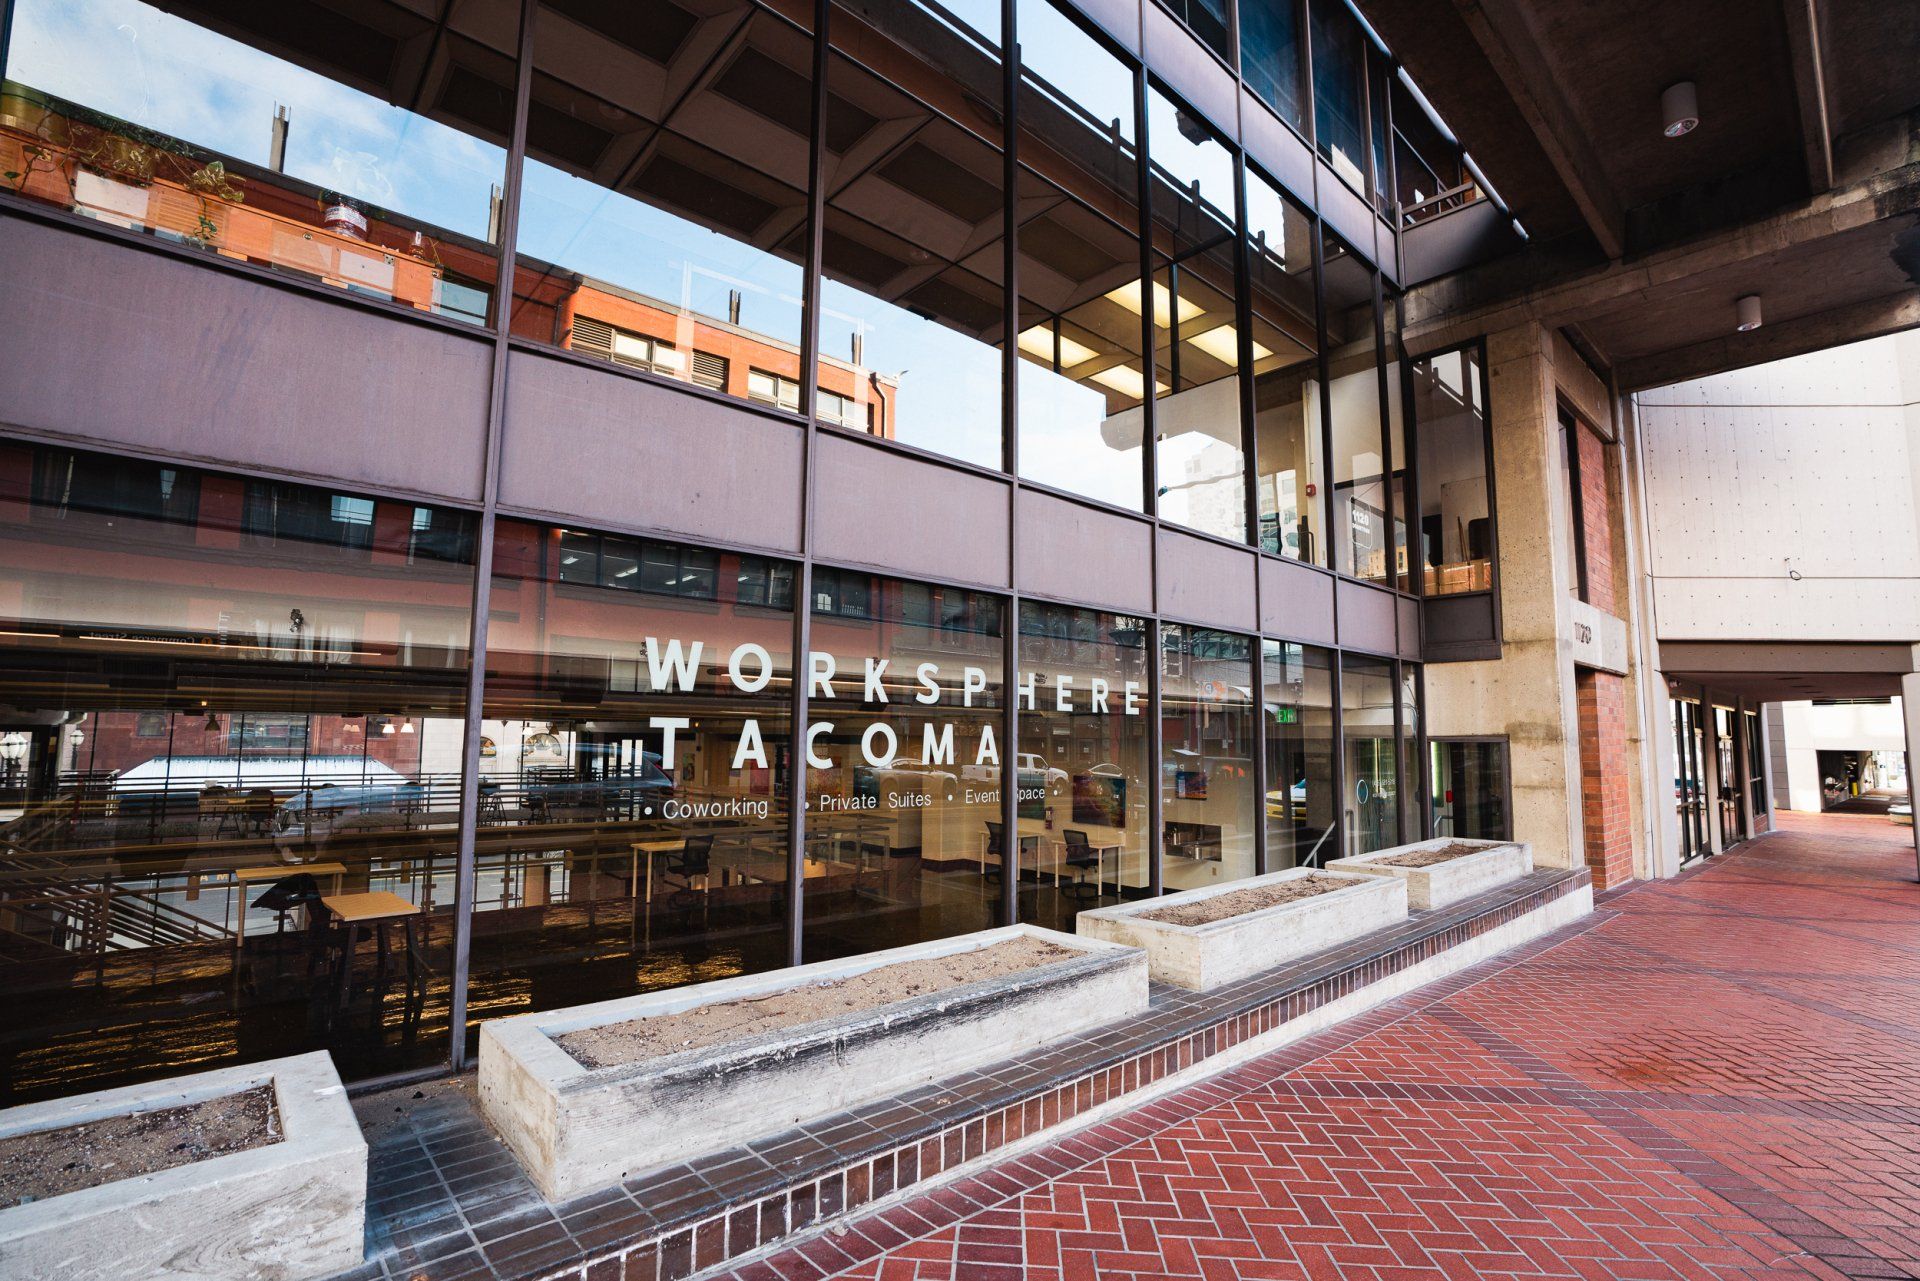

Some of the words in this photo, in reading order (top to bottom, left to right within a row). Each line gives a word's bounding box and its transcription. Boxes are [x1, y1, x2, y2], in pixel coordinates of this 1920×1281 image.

[650, 717, 999, 770] TACOMA
[663, 798, 768, 819] Coworking
[820, 793, 877, 812] Private
[888, 791, 932, 808] Suites
[965, 788, 1000, 804] Event
[1016, 788, 1045, 803] pace
